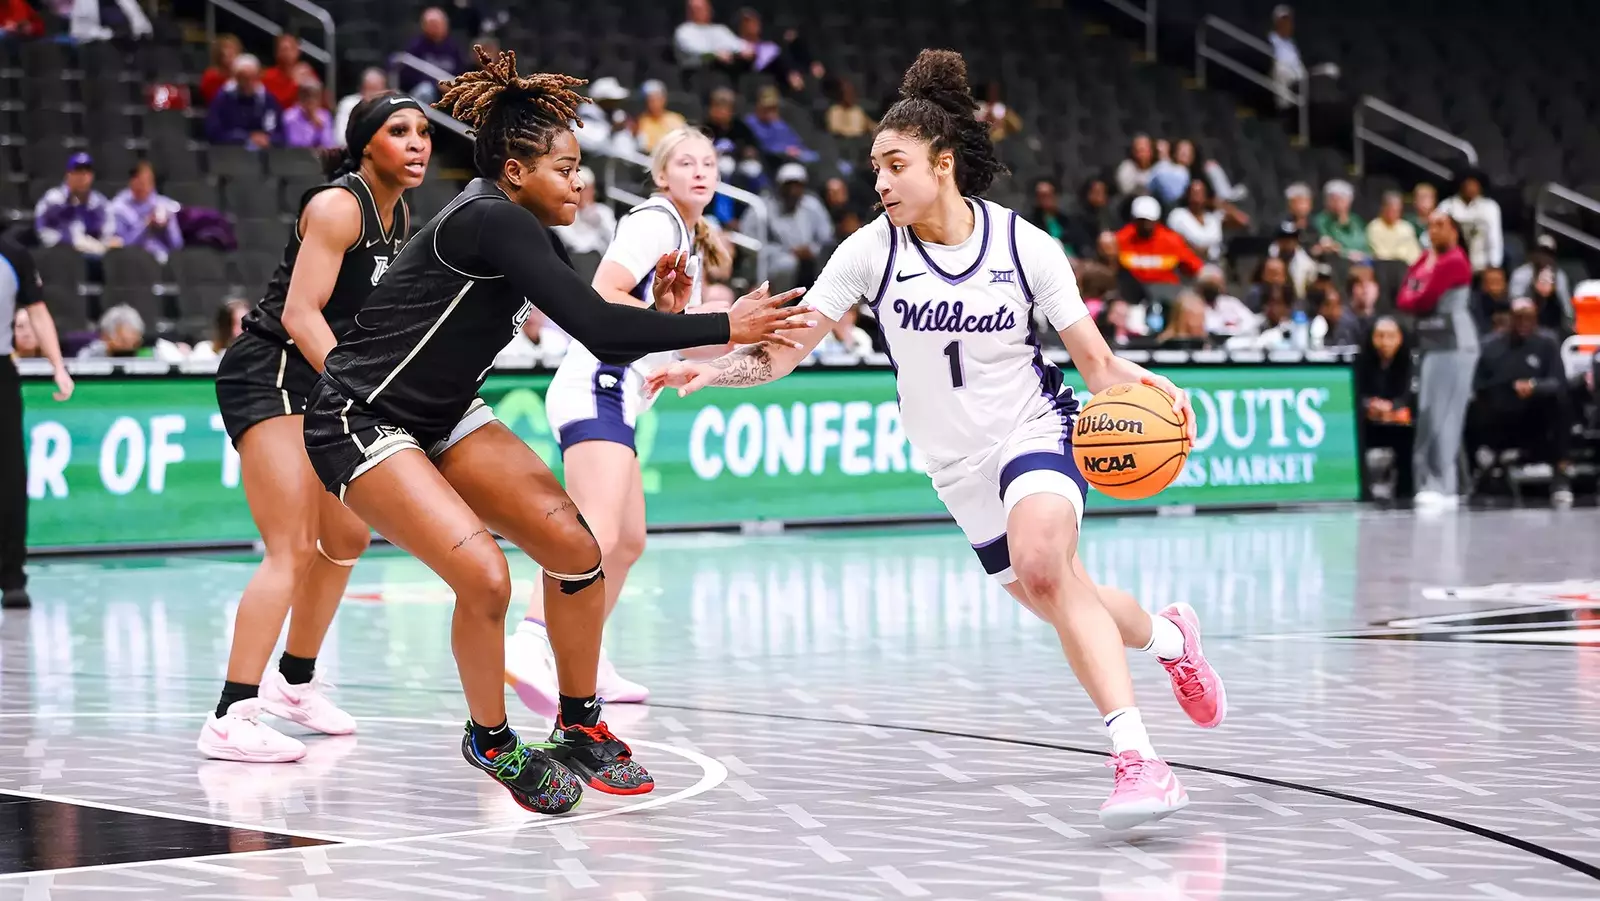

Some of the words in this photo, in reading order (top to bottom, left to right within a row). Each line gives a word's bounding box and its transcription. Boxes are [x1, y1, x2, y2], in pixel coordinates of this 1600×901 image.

[893, 298, 1017, 333] Wildcats
[943, 339, 967, 390] 1
[688, 400, 929, 481] CONFER
[1077, 413, 1144, 437] Wilson
[99, 414, 187, 496] OF
[1083, 452, 1137, 473] NCAA
[1209, 452, 1317, 487] MARKET
